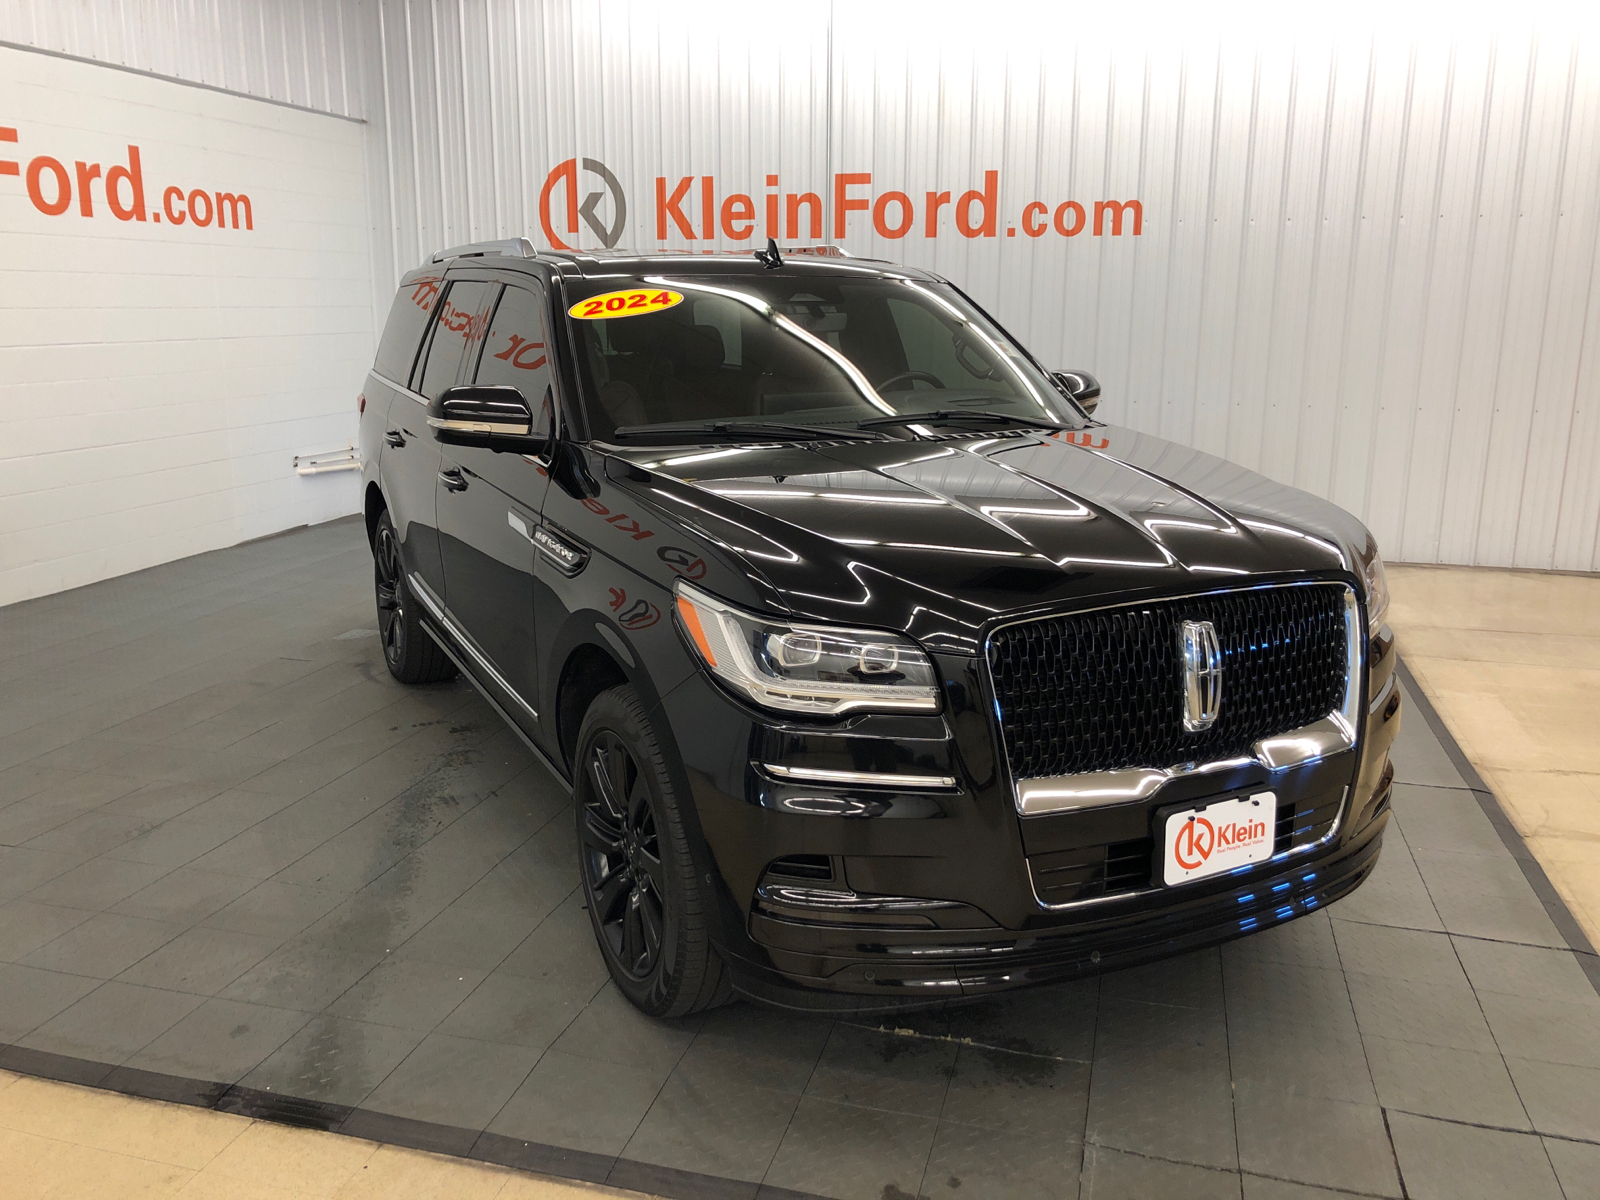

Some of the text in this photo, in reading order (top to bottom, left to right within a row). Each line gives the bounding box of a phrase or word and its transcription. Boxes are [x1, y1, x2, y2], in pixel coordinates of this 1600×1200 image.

[655, 169, 1144, 241] KleinFord.com
[583, 291, 673, 317] 2024
[1217, 818, 1266, 848] Klein
